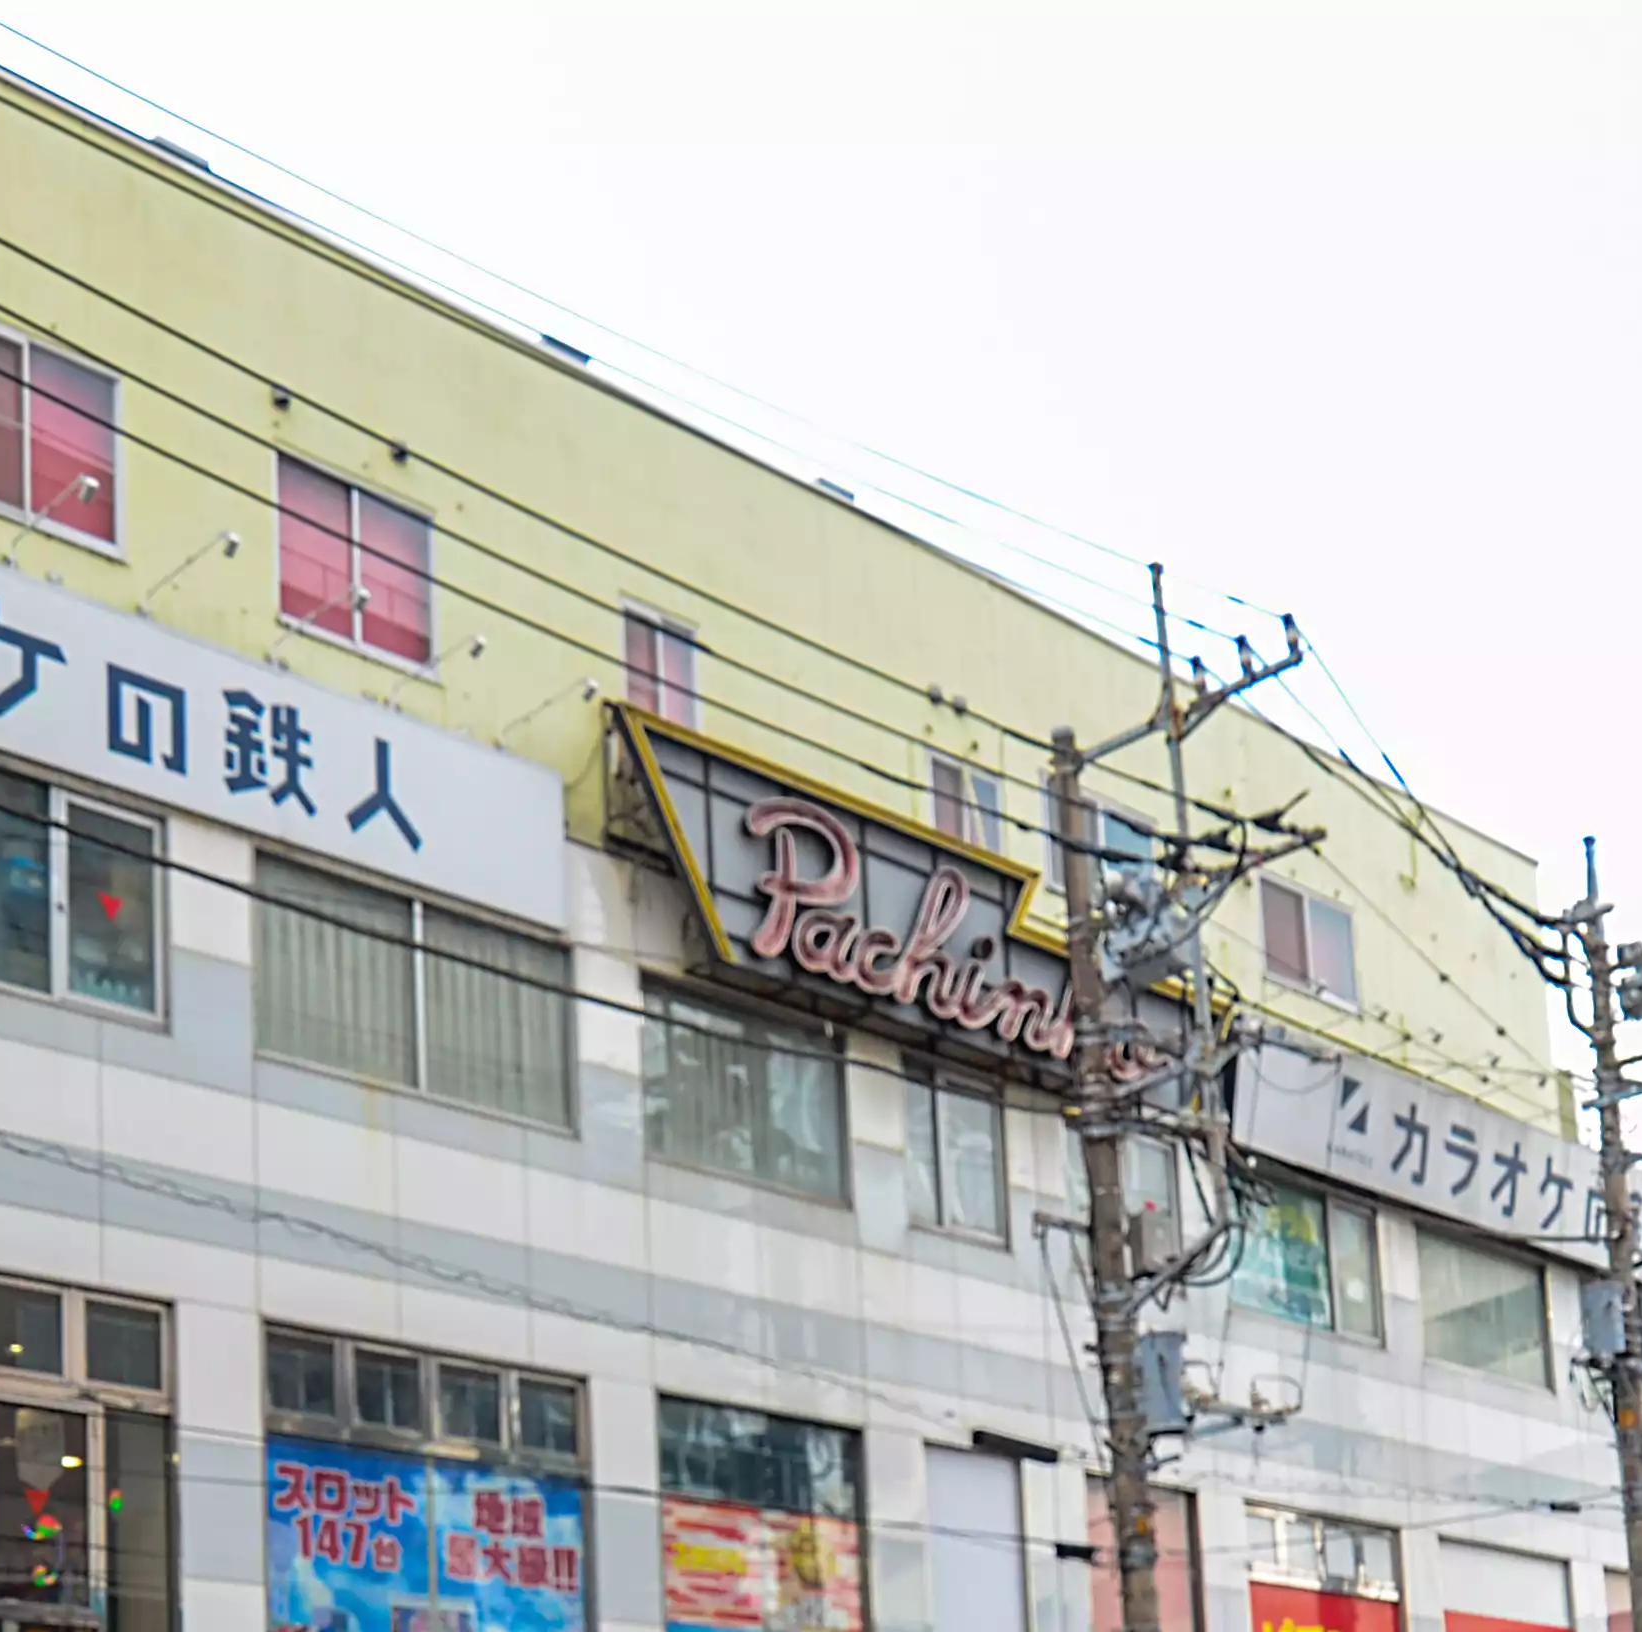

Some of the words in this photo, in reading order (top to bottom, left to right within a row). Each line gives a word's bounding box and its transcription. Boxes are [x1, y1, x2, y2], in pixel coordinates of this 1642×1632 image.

[745, 796, 1173, 1083] Pachino
[274, 1461, 416, 1525] スロット
